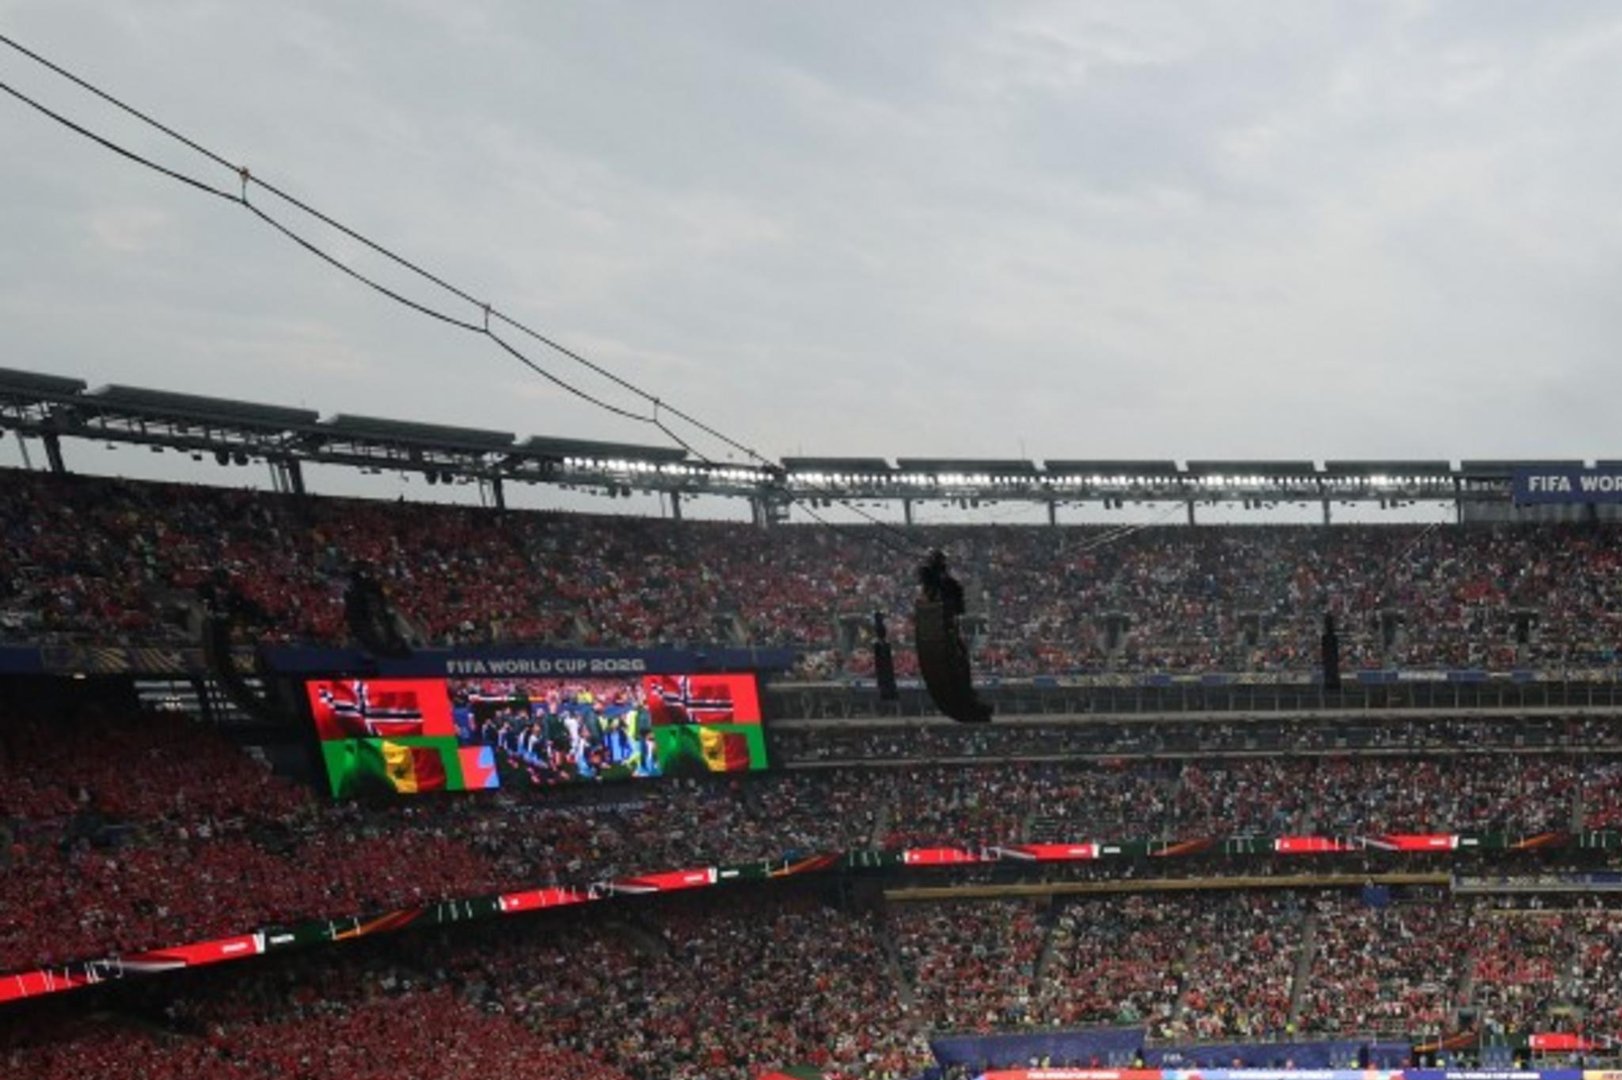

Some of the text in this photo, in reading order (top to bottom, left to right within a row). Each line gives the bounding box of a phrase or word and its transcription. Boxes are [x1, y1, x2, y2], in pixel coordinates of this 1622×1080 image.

[1528, 476, 1572, 492] FIFA
[446, 658, 646, 673] FIFA WORLD CUP 2026
